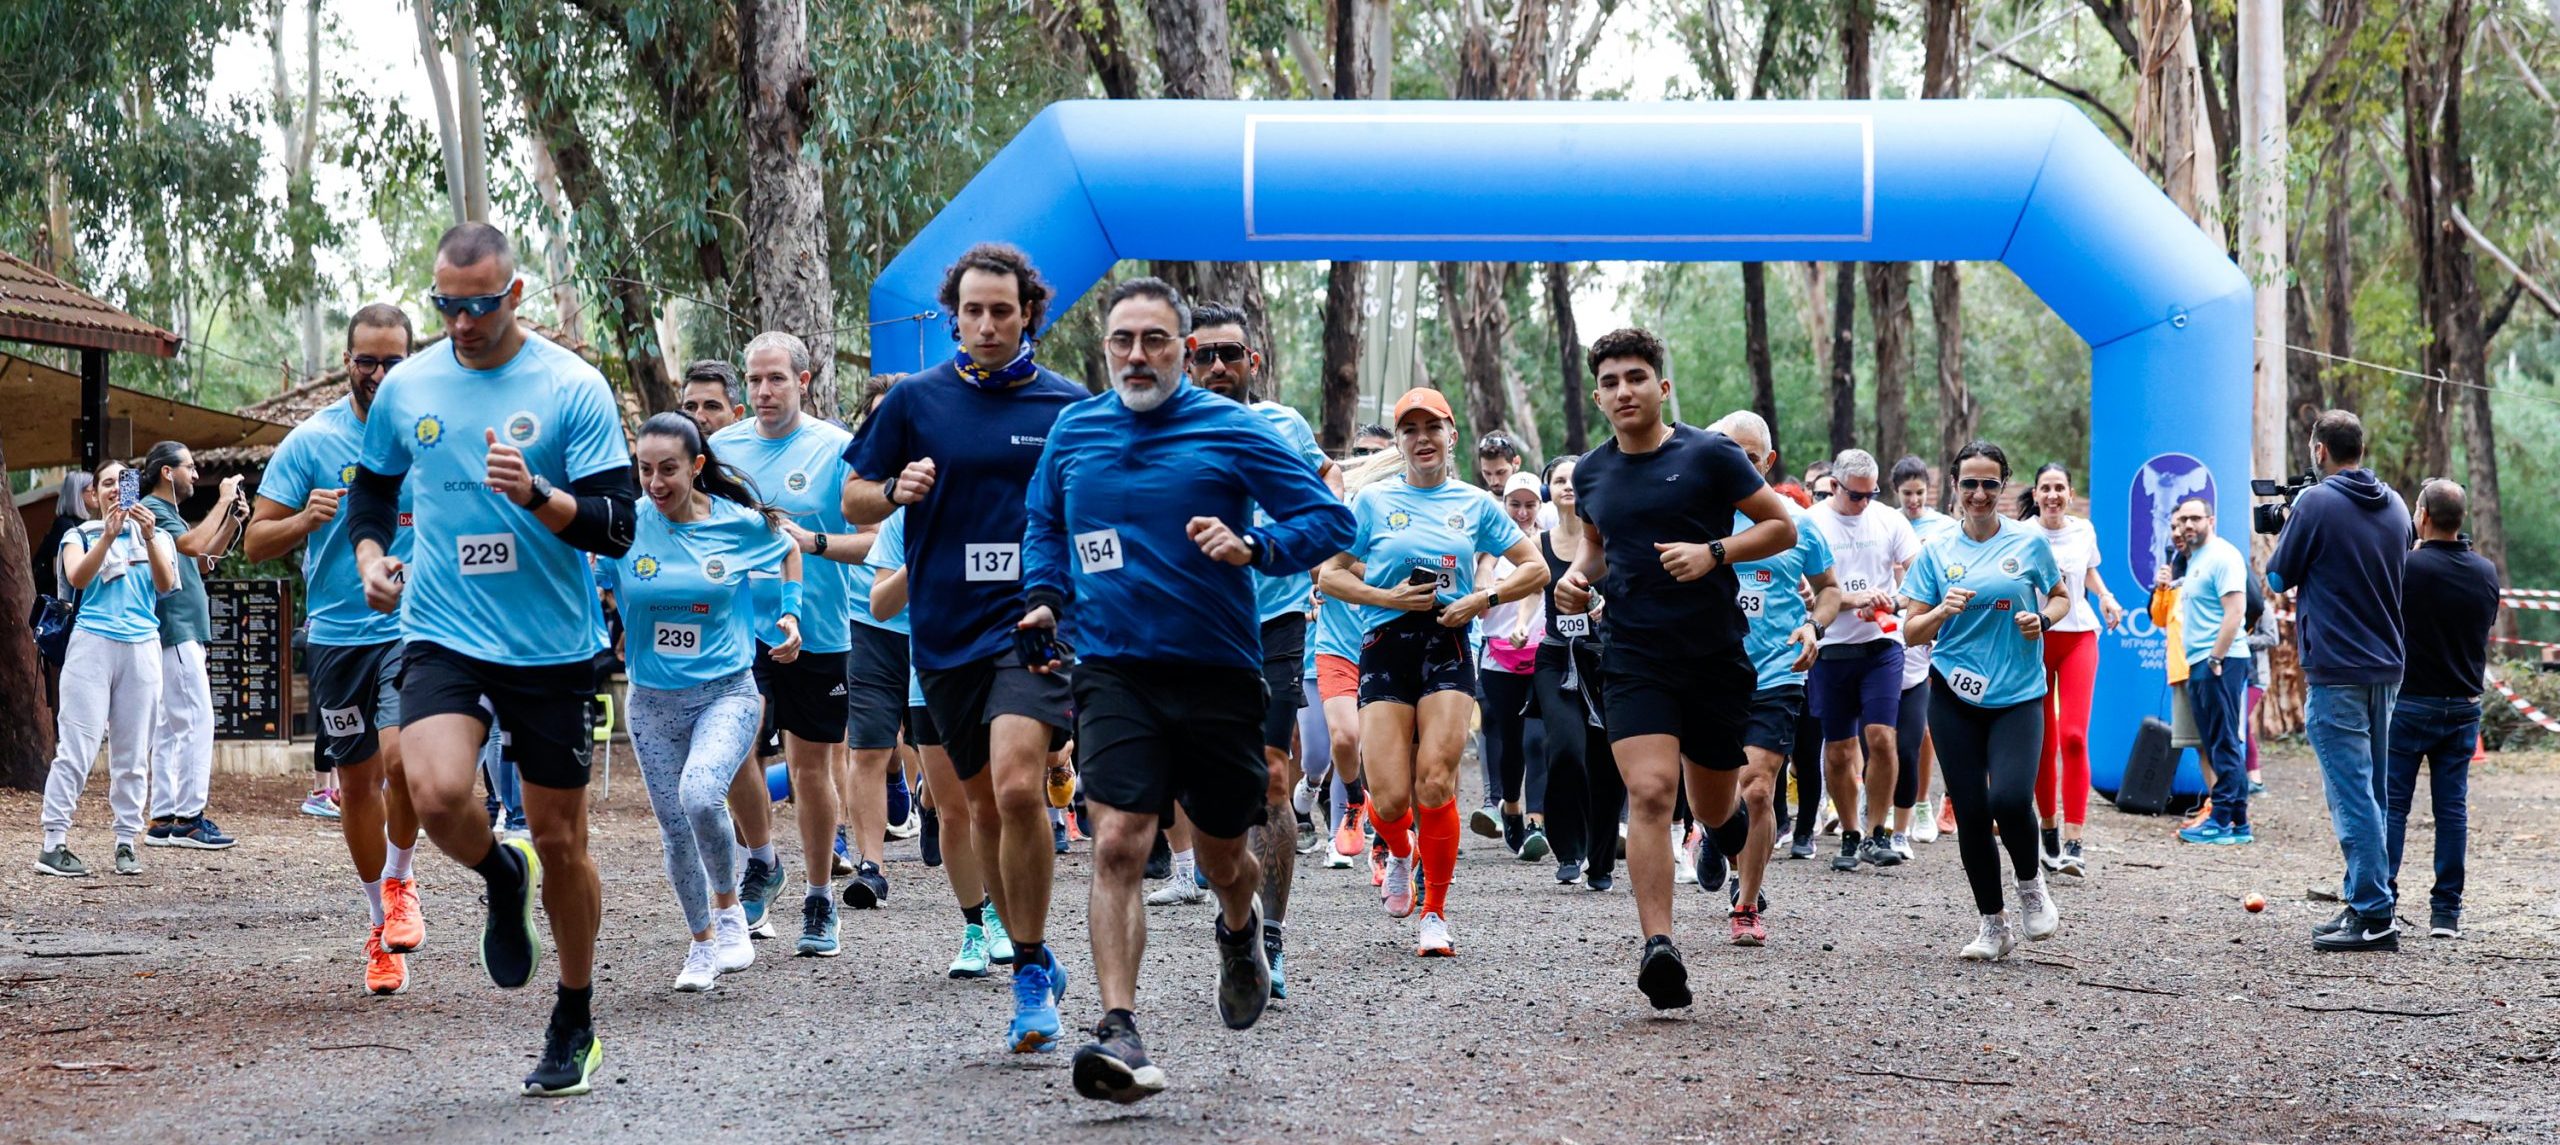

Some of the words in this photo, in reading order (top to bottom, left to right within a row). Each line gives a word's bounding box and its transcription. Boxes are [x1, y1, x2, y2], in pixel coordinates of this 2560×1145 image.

[462, 542, 509, 566] 229
[1080, 538, 1115, 564] 154
[971, 552, 1014, 572] 137
[1844, 578, 1867, 592] 166
[1739, 595, 1760, 612] 63
[1964, 600, 2010, 611] commbx
[1560, 618, 1585, 632] 209
[657, 628, 696, 649] 239
[1952, 672, 1983, 696] 183
[325, 712, 358, 731] 164
